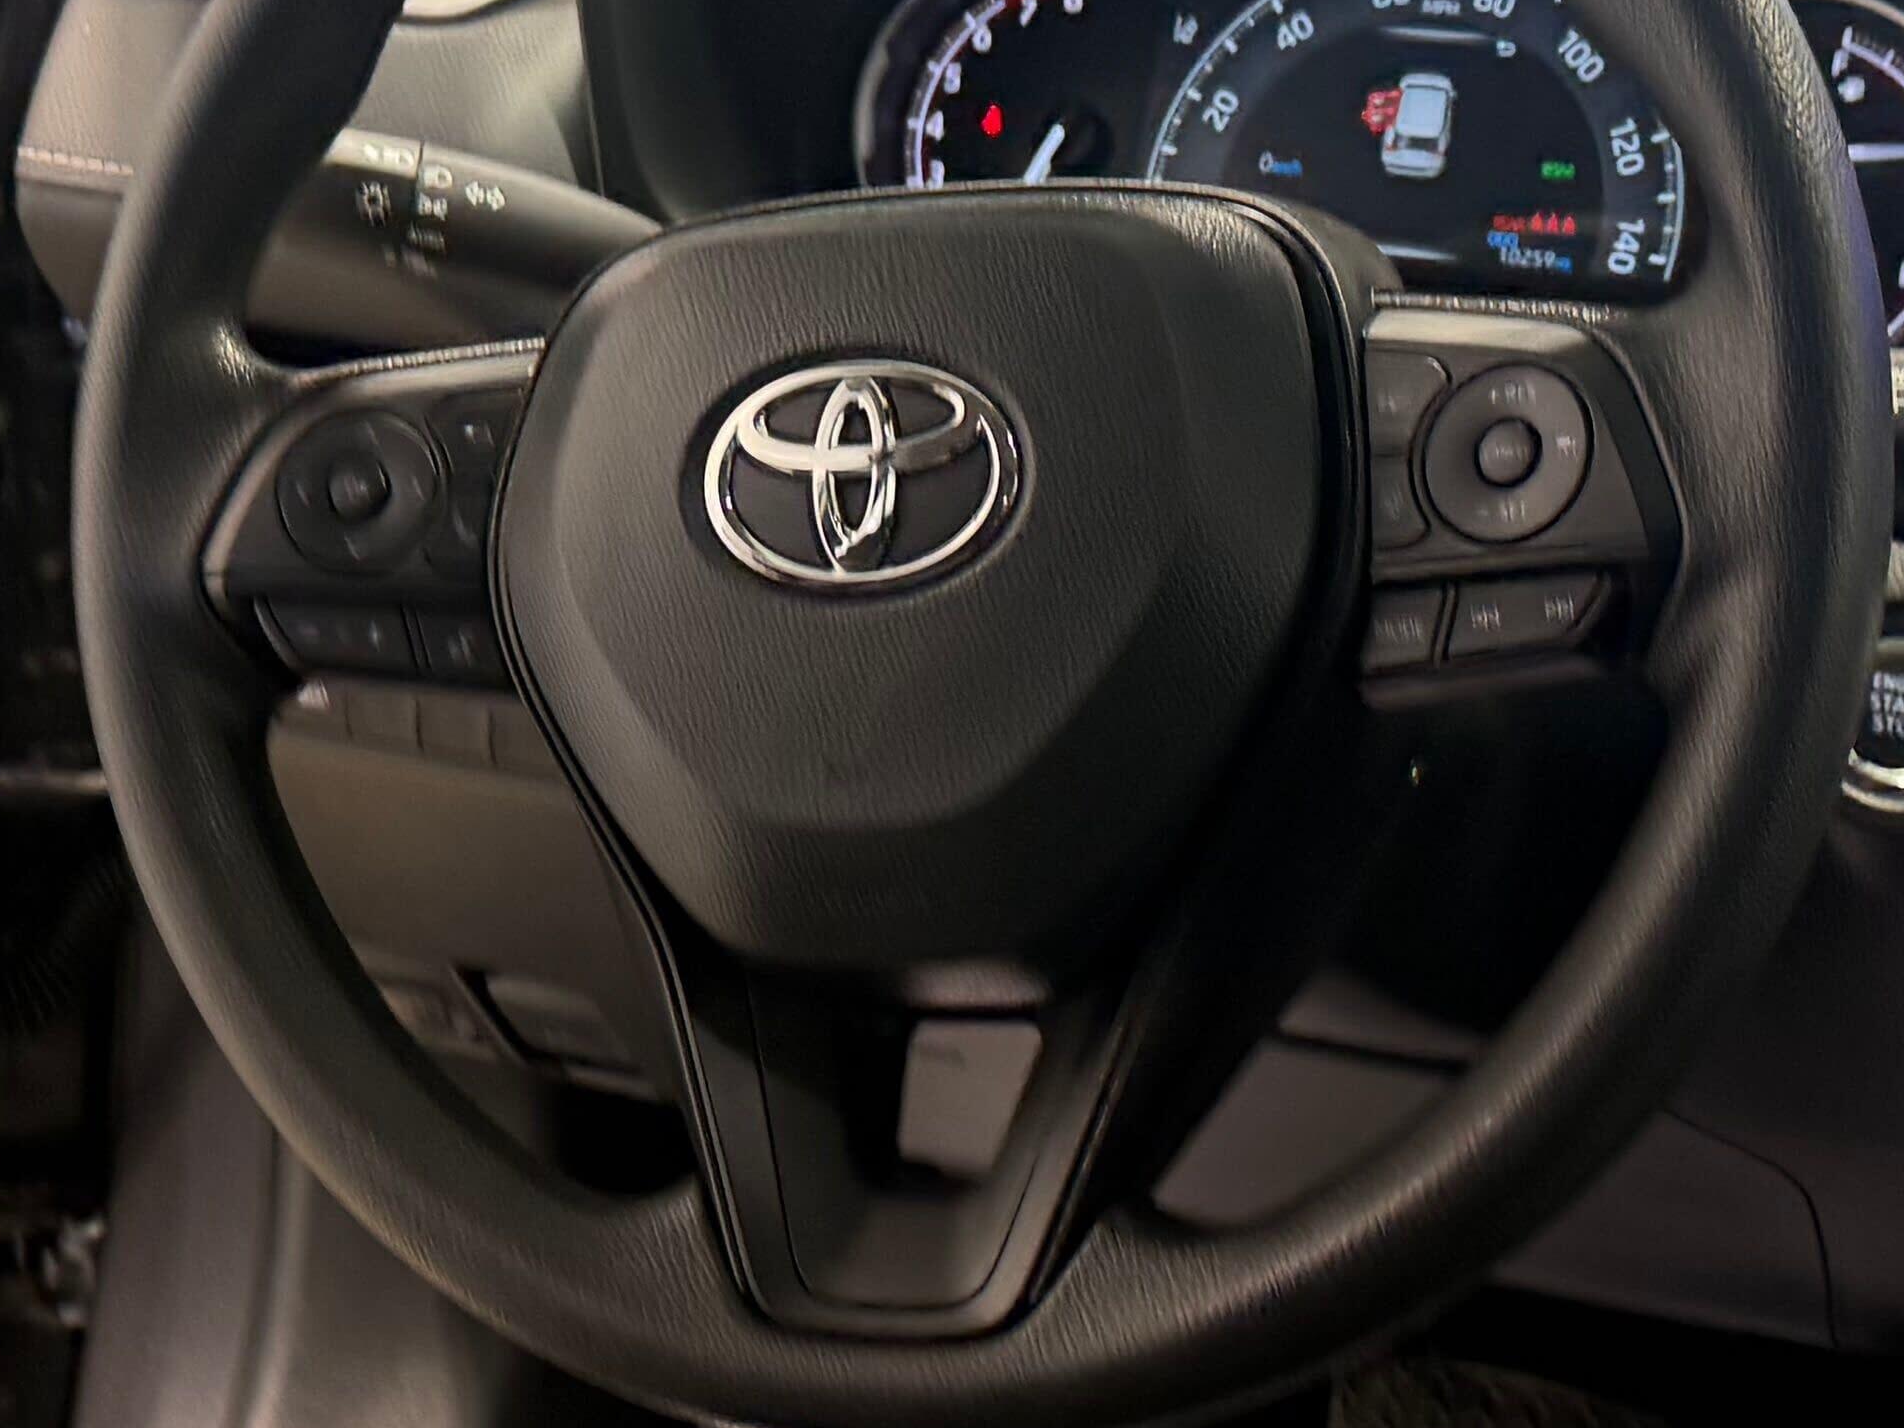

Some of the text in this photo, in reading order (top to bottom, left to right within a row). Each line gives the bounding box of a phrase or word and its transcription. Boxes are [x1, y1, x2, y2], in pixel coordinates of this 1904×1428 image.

[1276, 10, 1315, 51] 40
[1558, 27, 1606, 84] 100
[1201, 89, 1240, 133] 20
[1609, 116, 1646, 177] 120
[1607, 218, 1646, 275] 140
